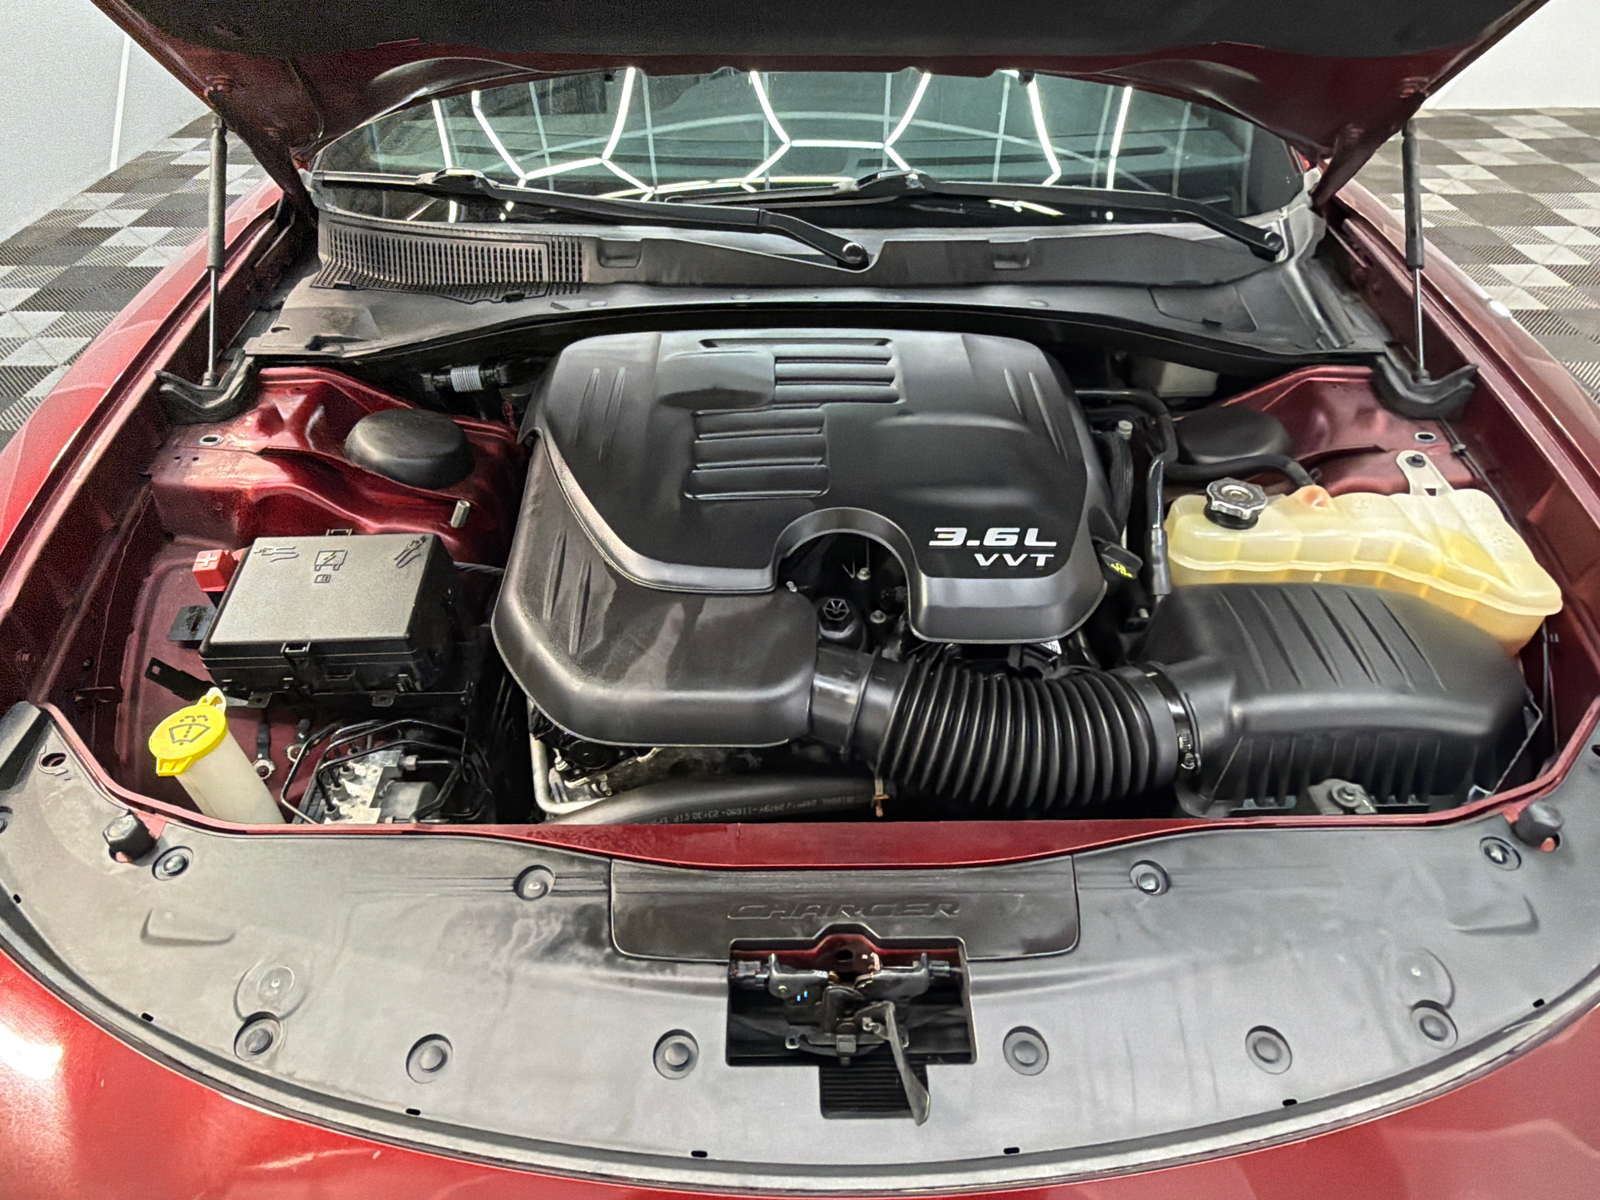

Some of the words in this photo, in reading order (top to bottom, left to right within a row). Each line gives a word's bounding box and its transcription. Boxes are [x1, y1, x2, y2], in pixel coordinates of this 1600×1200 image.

[928, 527, 1057, 547] 3.6L
[973, 553, 1055, 567] VVT
[727, 903, 961, 920] CHARGER
